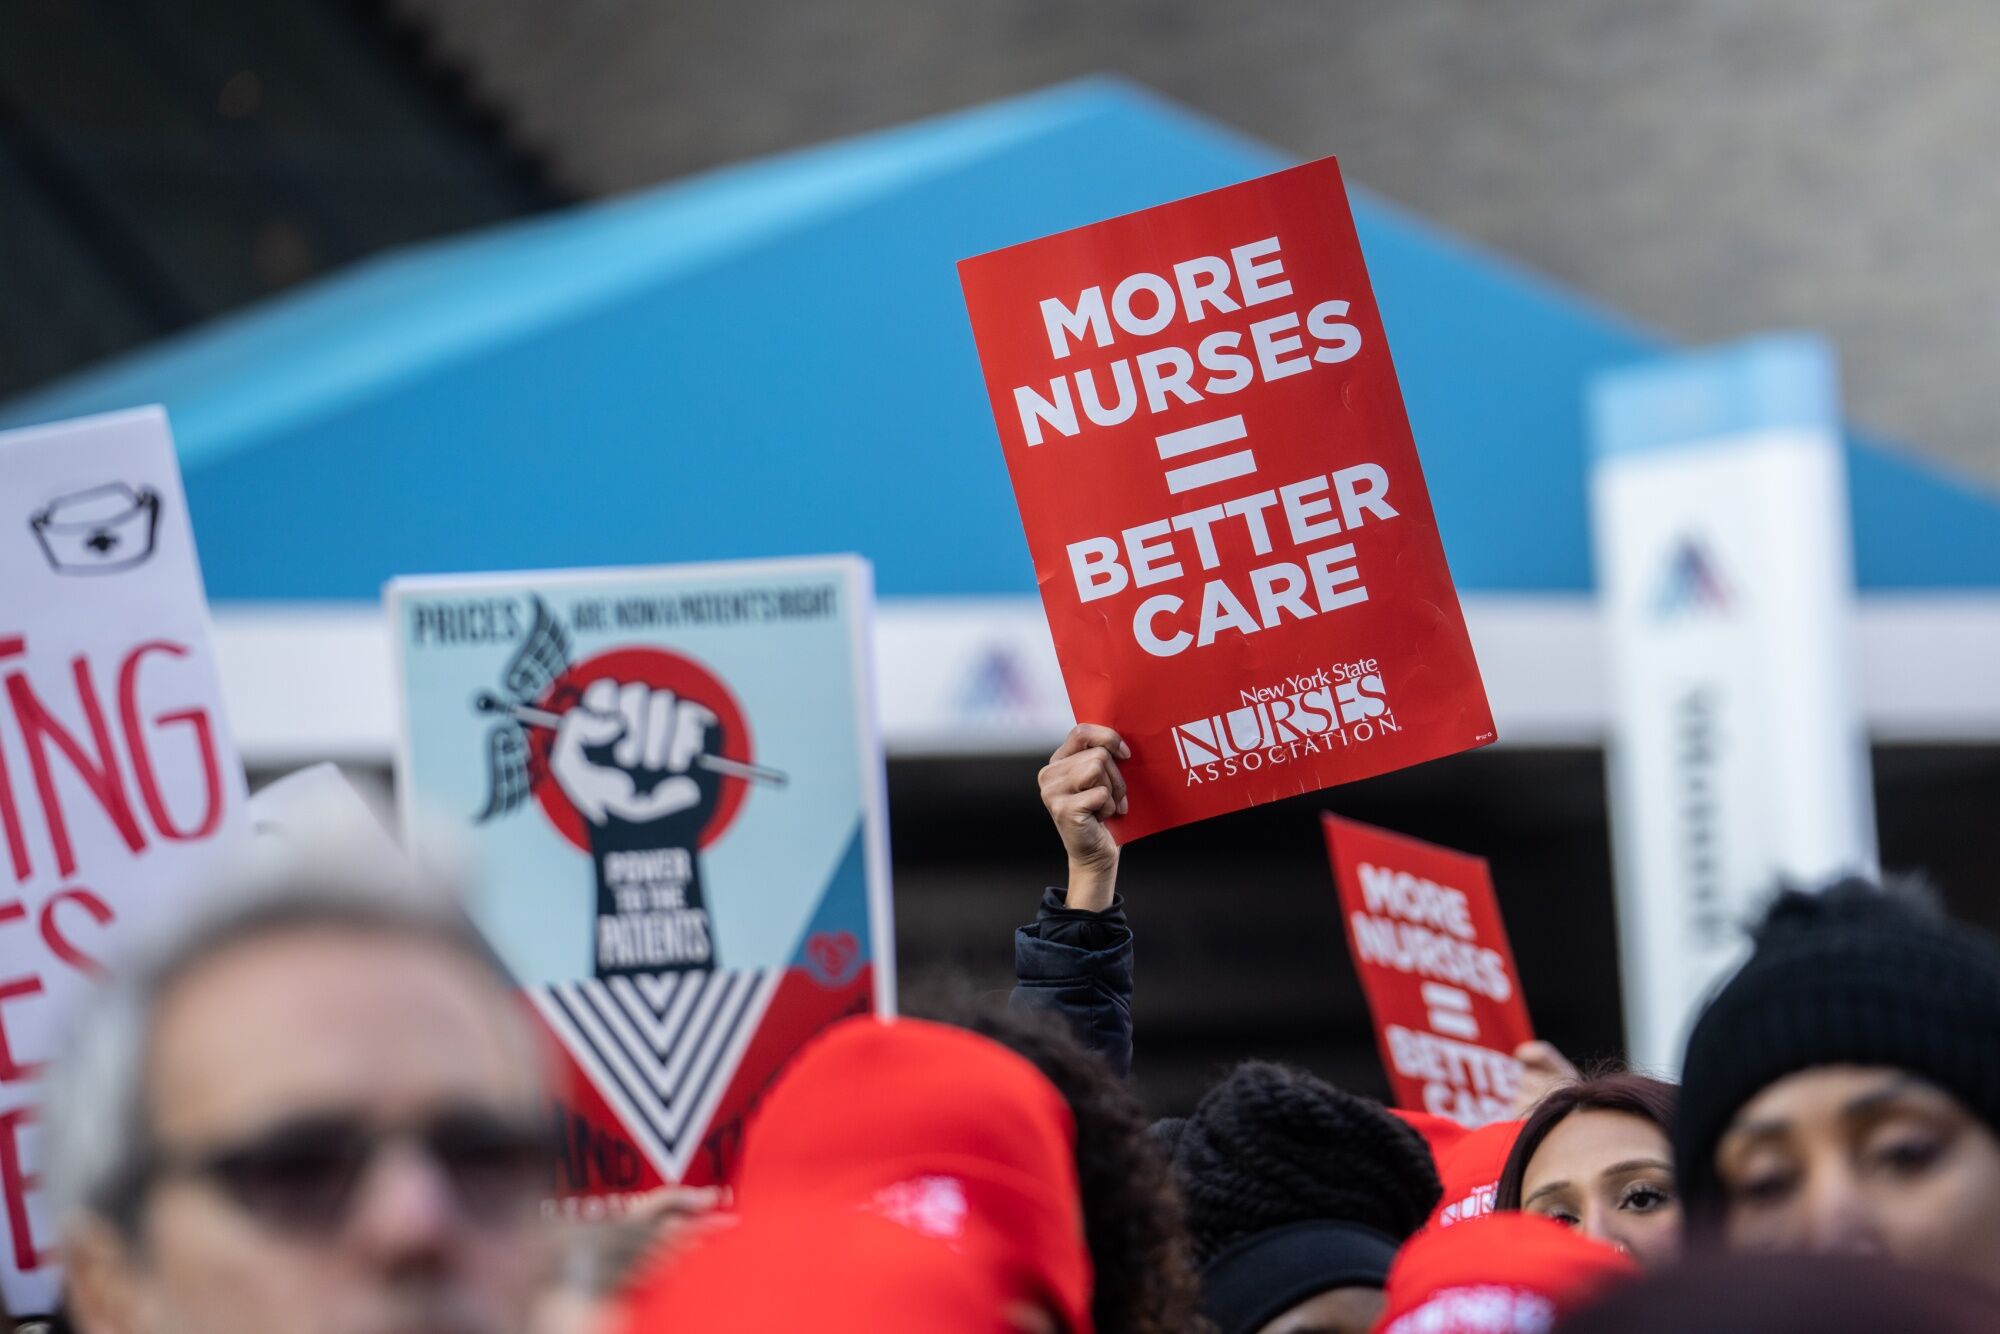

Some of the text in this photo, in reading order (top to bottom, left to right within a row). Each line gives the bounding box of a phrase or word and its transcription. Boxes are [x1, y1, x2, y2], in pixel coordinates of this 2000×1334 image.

[1039, 236, 1294, 360] MORE
[1012, 299, 1362, 448] NURSES
[1065, 462, 1400, 604] BETTER
[413, 599, 520, 645] PRICES
[1132, 542, 1369, 657] CARE
[1171, 670, 1393, 770] NURSES
[1240, 658, 1379, 707] New York State
[1186, 714, 1398, 787] ASSOCIATION
[603, 847, 693, 887] POWER
[1357, 861, 1477, 941] MORE
[597, 908, 711, 969] PATIENTS
[1351, 909, 1512, 1004] NURSES
[1385, 1023, 1526, 1101] BETTE
